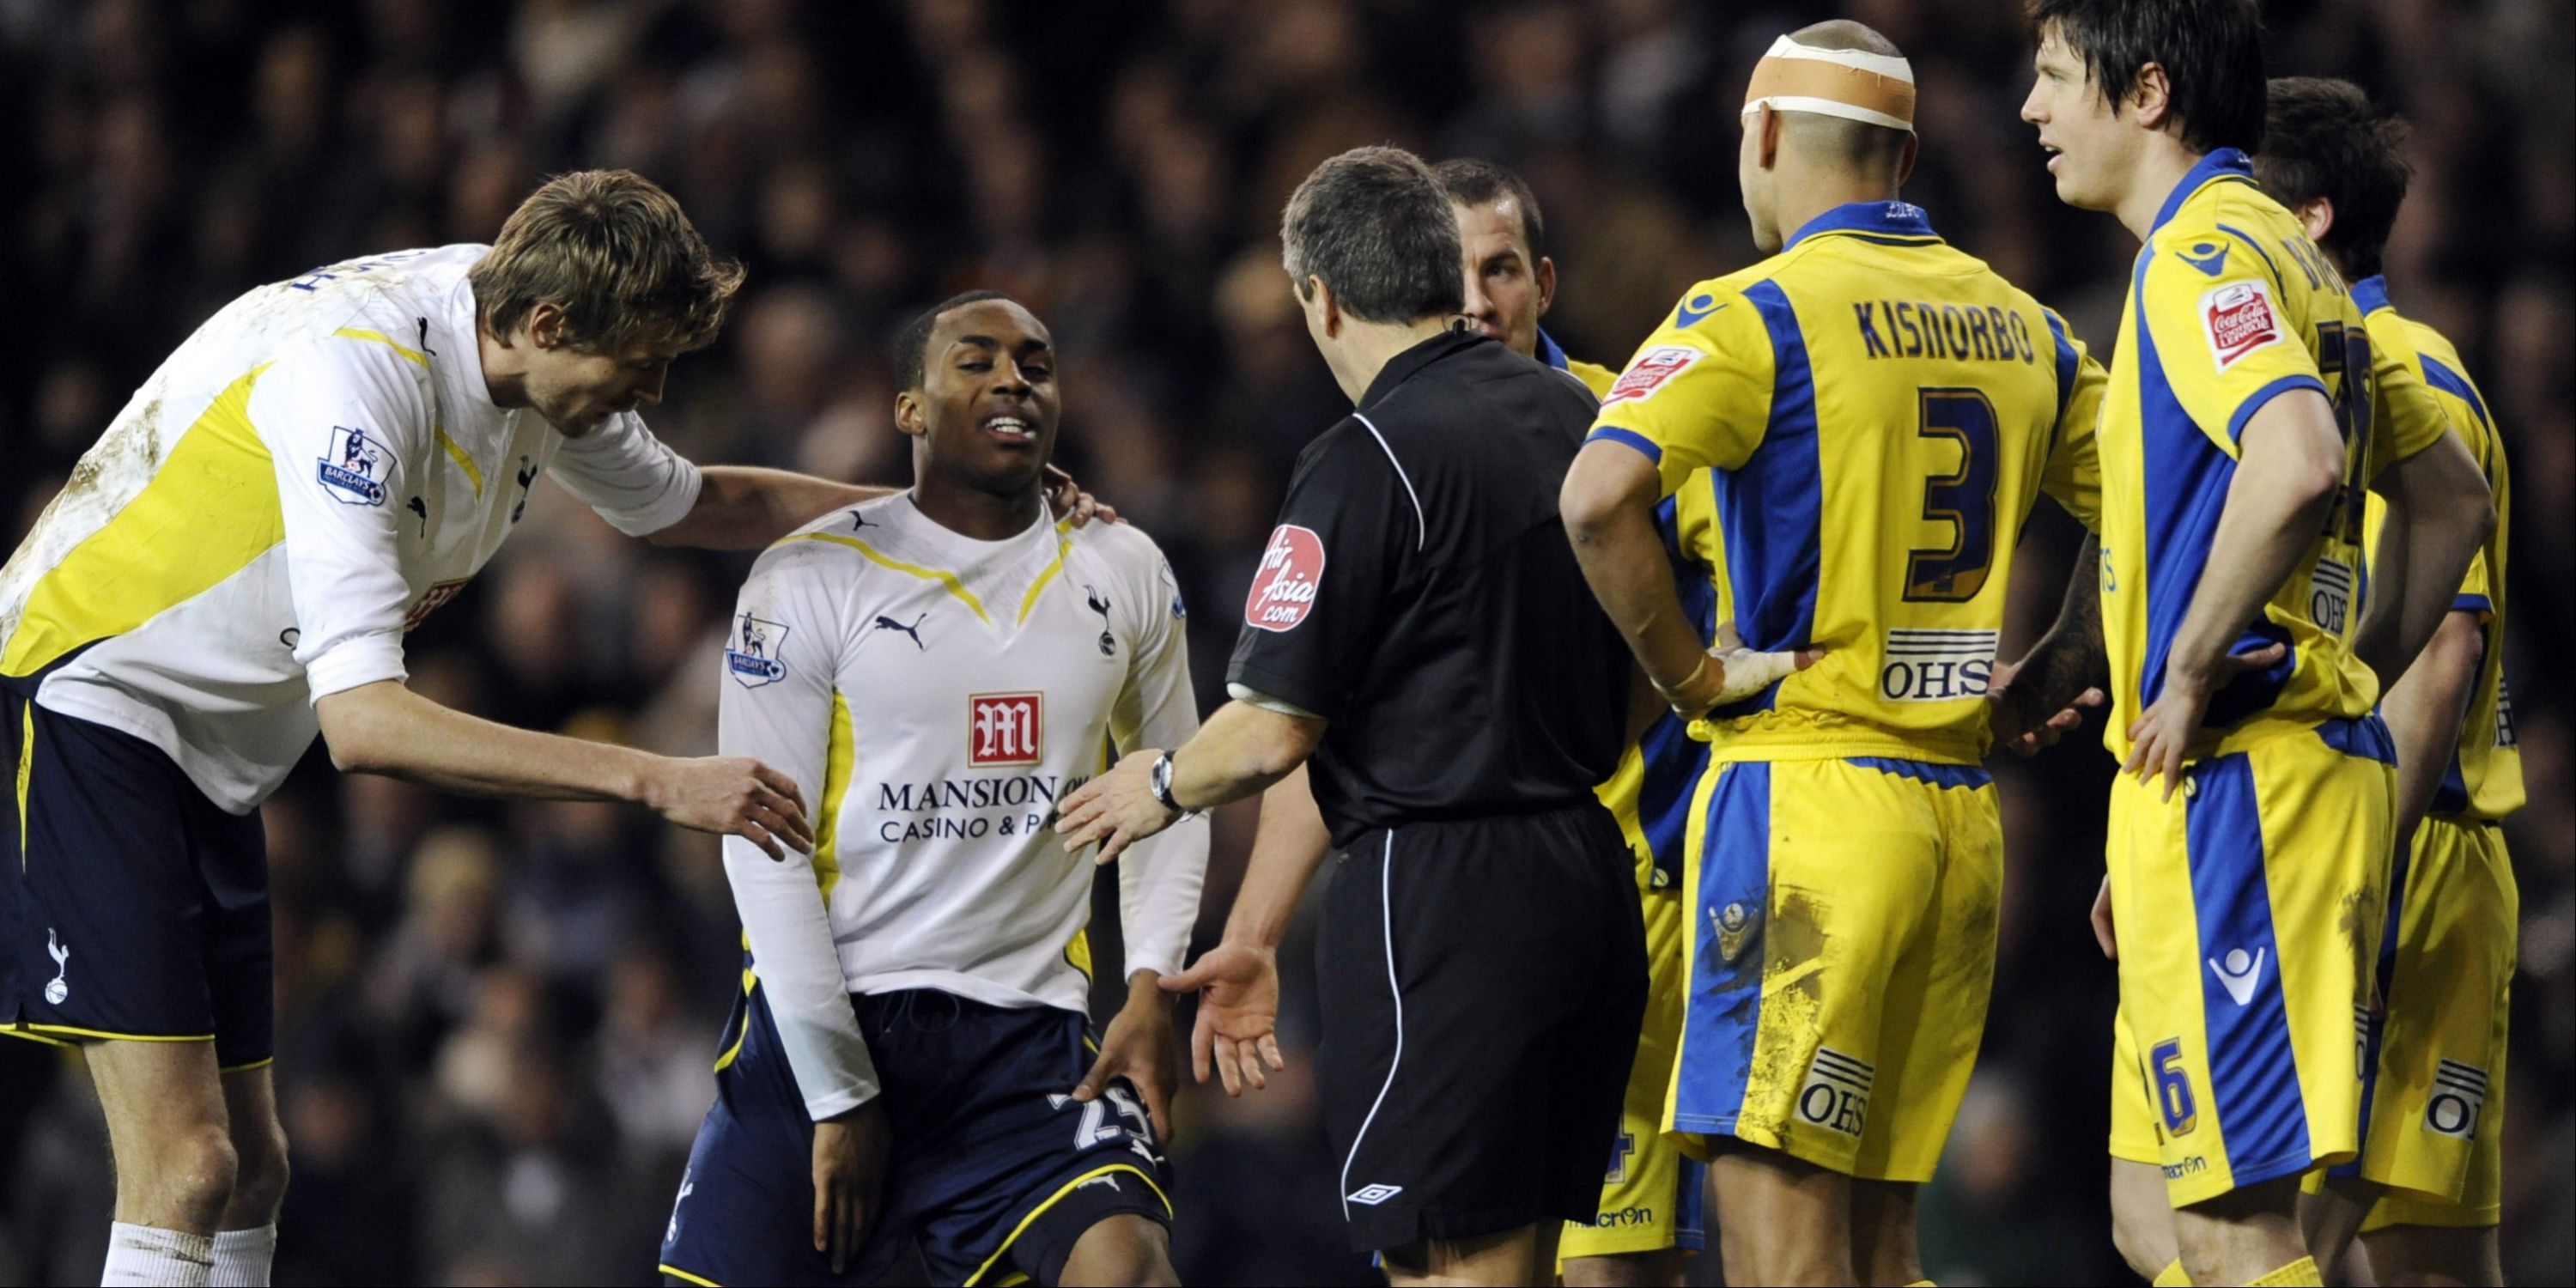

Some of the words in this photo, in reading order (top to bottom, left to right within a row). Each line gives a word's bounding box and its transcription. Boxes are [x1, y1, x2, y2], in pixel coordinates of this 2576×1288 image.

[1853, 301, 2034, 365] KISNORBO
[325, 466, 369, 490] BARCLAYS
[1901, 386, 2000, 603] 3
[1255, 525, 1293, 579] Air
[1255, 559, 1315, 611] Asia
[1882, 659, 1994, 699] OHS
[878, 775, 1058, 811] MANSION
[880, 817, 989, 842] CASINO
[999, 816, 1014, 835] &
[1800, 1083, 1867, 1137] OHS
[1570, 1207, 1652, 1228] cron
